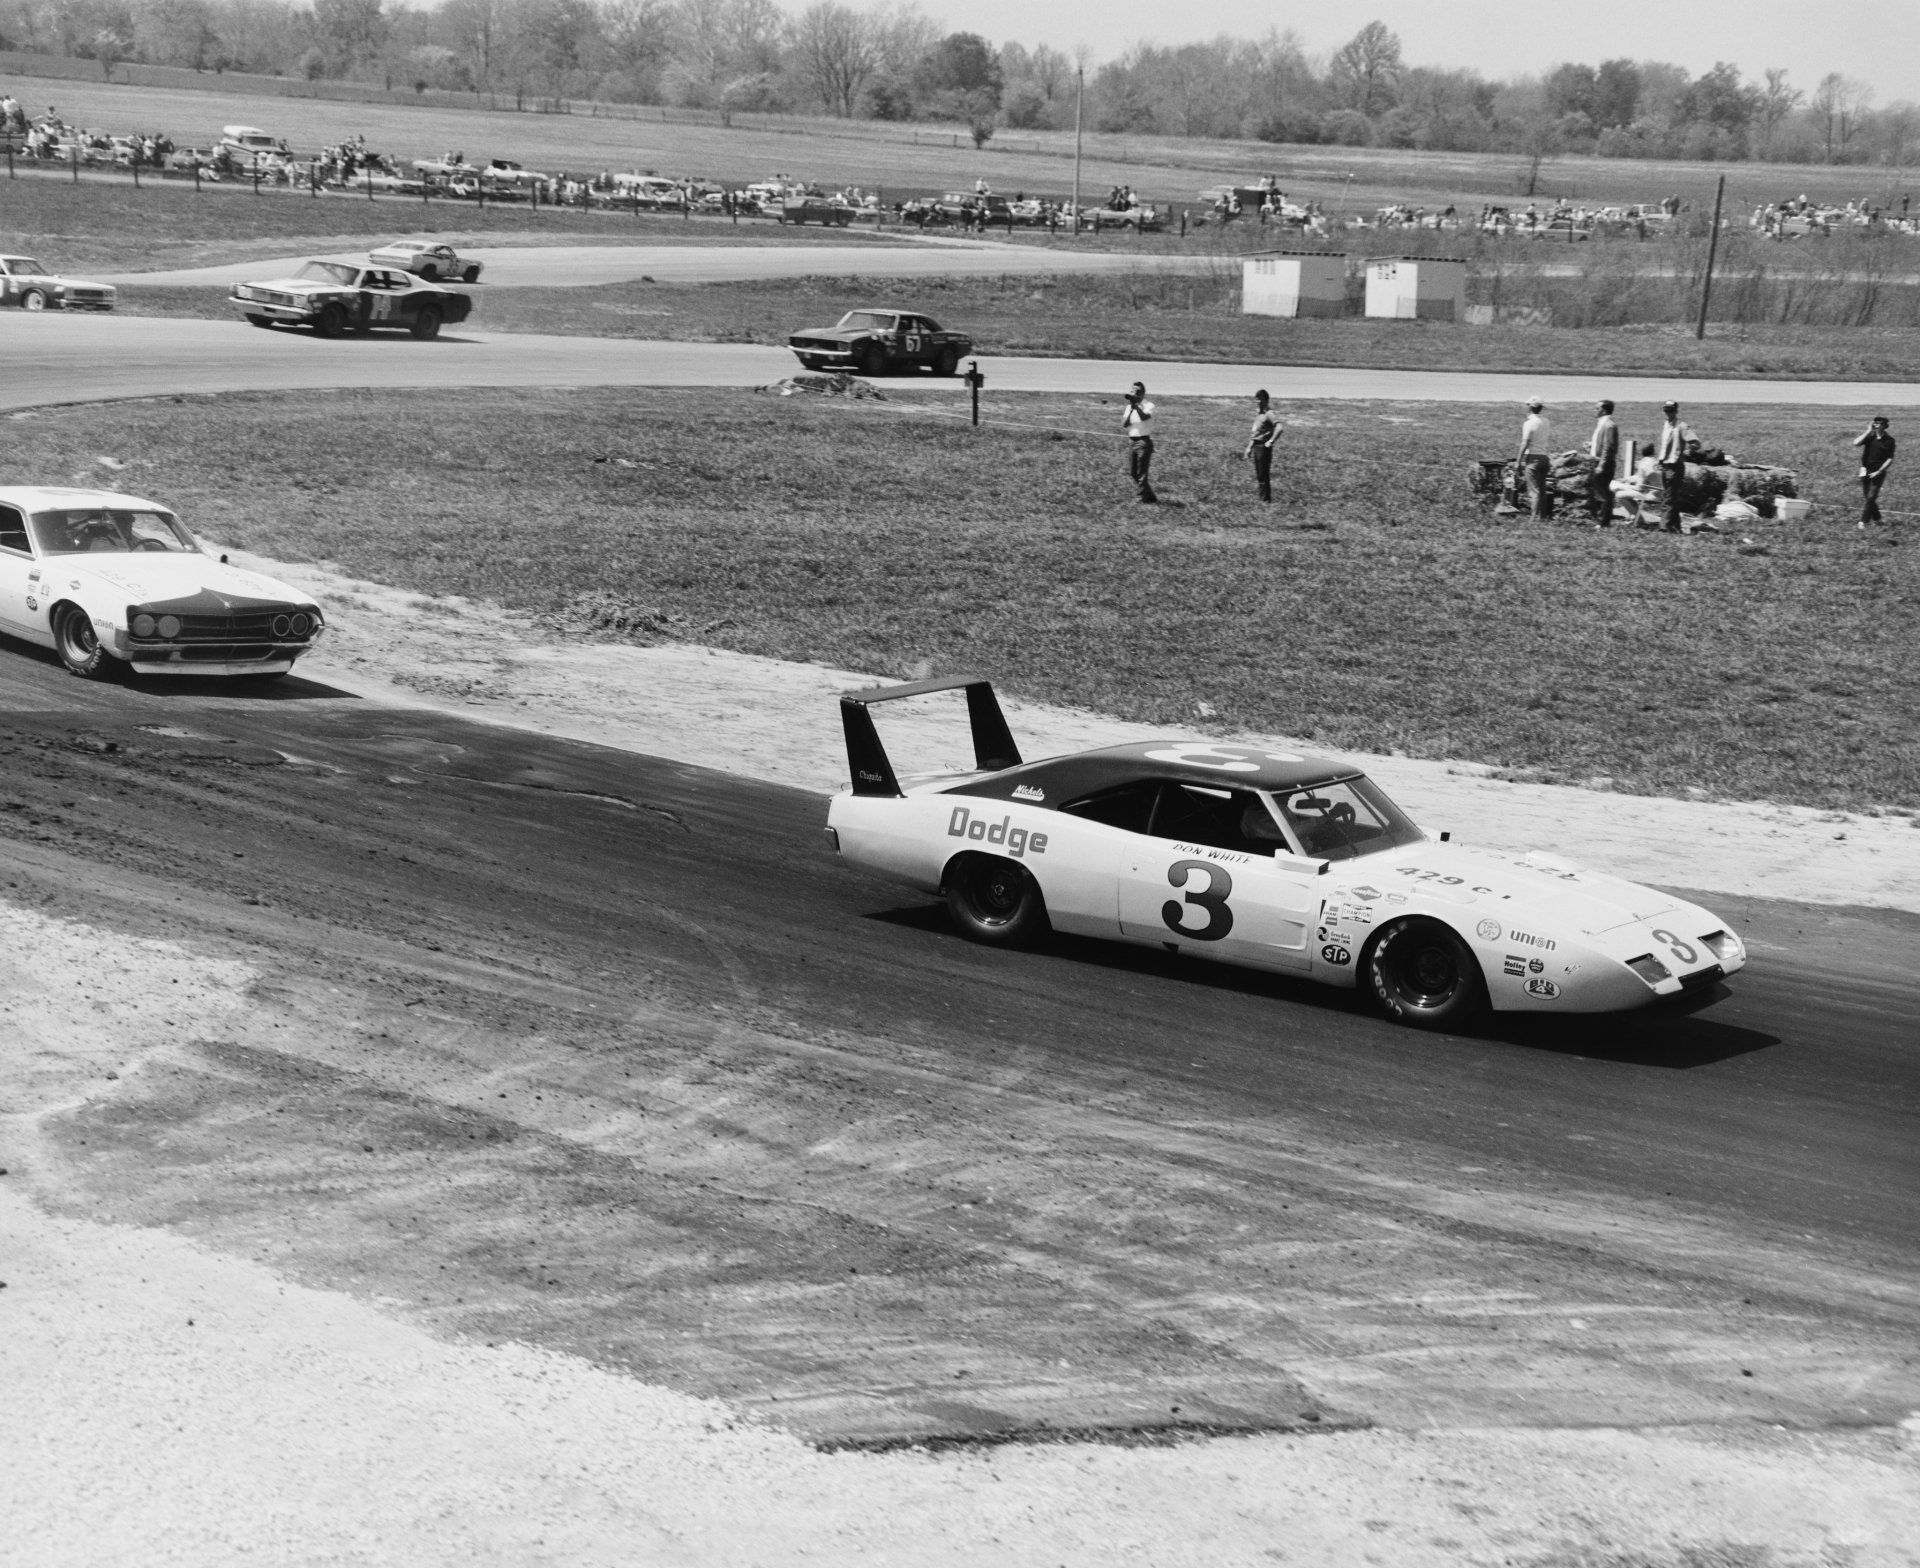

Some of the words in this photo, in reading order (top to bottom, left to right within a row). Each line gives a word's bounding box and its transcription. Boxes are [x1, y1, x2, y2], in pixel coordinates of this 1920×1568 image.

[948, 806, 1048, 858] Dodge
[1173, 843, 1202, 855] DON
[1207, 849, 1254, 865] WHITE
[1396, 867, 1465, 885] 429
[1161, 859, 1234, 941] 3
[1324, 946, 1348, 962] STP
[1652, 929, 1698, 965] 3
[1504, 961, 1525, 972] Holley
